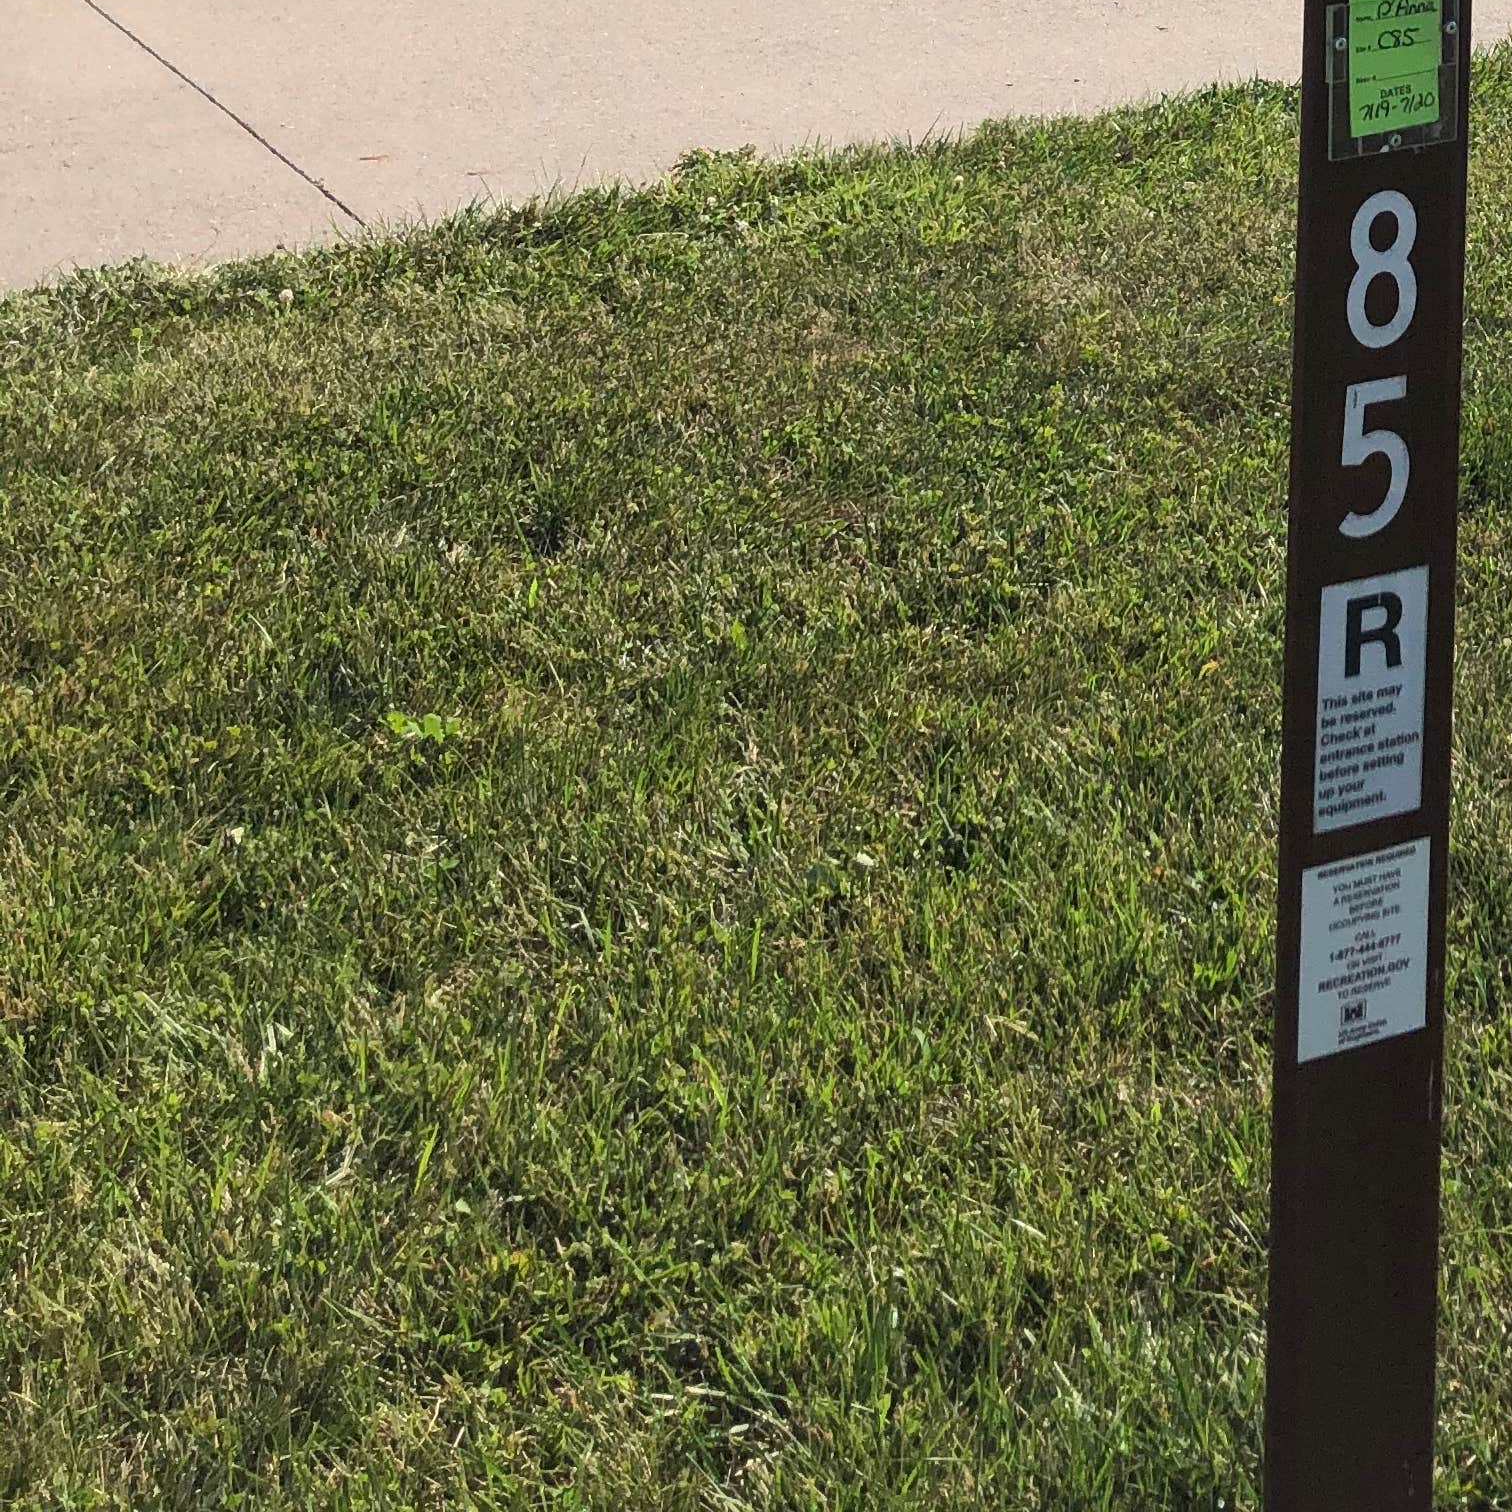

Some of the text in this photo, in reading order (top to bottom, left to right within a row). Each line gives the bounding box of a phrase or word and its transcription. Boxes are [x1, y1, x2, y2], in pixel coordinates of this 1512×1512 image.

[1378, 27, 1420, 50] C85
[1380, 84, 1412, 99] DATES
[1344, 590, 1403, 679] R
[1322, 684, 1403, 711] This site may
[1321, 701, 1397, 729] be reserved.
[1320, 731, 1420, 764] entrance station
[1321, 723, 1376, 746] Check at
[1319, 752, 1405, 781] before setting
[1318, 779, 1365, 800] up your
[1318, 789, 1387, 818] equipment.
[1317, 844, 1417, 880] RESERVATION REQUIRED
[1332, 867, 1402, 894] YOU MUST HAVE
[1333, 879, 1400, 906] A RESERVATION
[1328, 903, 1400, 932] OCCUPYING SITE
[1349, 895, 1384, 915] BEFORE
[1354, 929, 1376, 942] CALL
[1318, 956, 1410, 993] RECREATION.GOV
[1338, 988, 1349, 1000] TO
